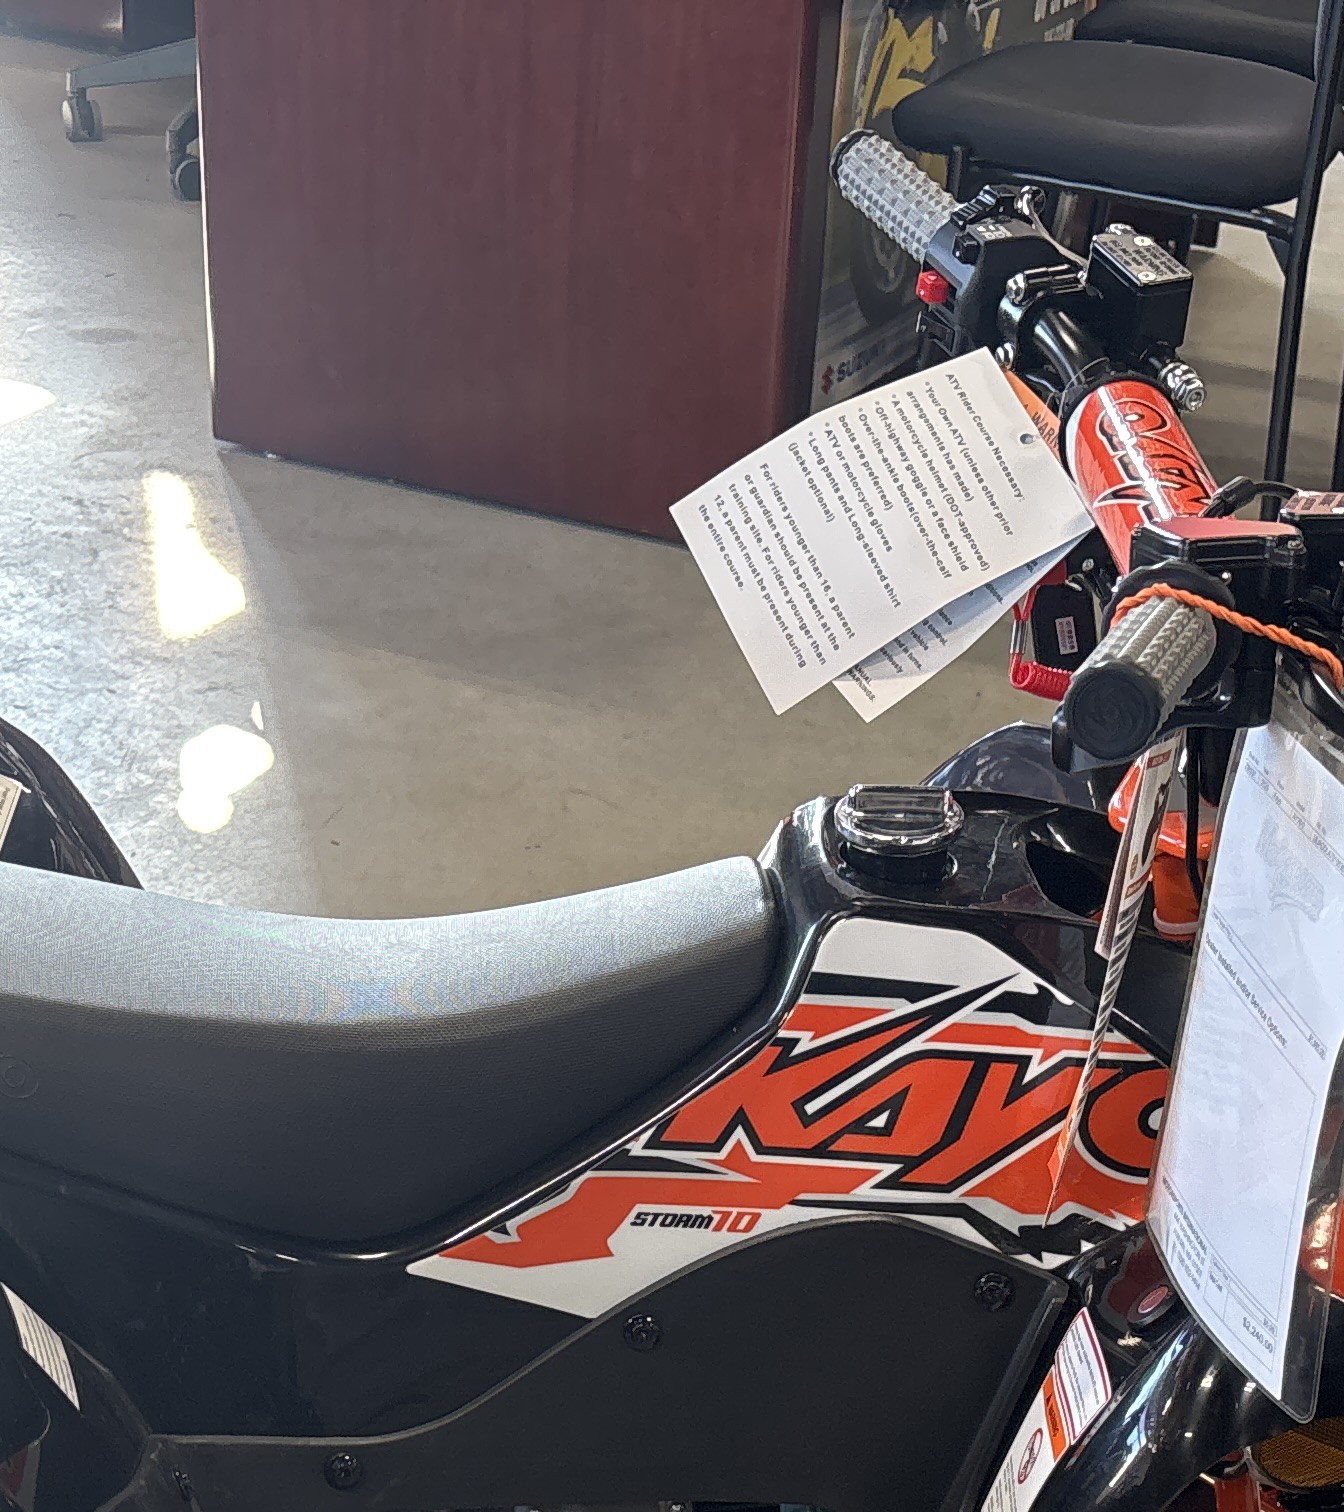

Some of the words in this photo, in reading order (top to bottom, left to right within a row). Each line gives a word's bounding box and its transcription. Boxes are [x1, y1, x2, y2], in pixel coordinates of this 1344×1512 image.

[788, 442, 811, 476] (jacket
[807, 477, 834, 522] optional)
[838, 414, 856, 442] boots
[853, 443, 865, 459] are
[860, 460, 893, 510] preferred)
[906, 391, 945, 451] arrangements
[942, 451, 955, 470] has
[952, 471, 974, 501] made)
[925, 386, 941, 406] Your
[938, 407, 952, 427] Own
[949, 428, 966, 445] ATV
[959, 447, 984, 483] (unless
[981, 485, 999, 510] other
[994, 511, 1013, 535] prior
[945, 374, 961, 389] ATV
[957, 391, 975, 414] Rider
[972, 415, 994, 446] Course
[698, 504, 709, 522] the
[707, 523, 725, 552] entire
[723, 553, 743, 592] course.
[744, 474, 753, 484] or
[749, 486, 776, 530] guardian
[774, 531, 796, 566] should
[792, 566, 802, 580] be
[798, 581, 824, 621] present
[820, 621, 830, 633] at
[827, 632, 839, 650] the
[759, 462, 772, 480] For
[769, 482, 787, 512] riders
[783, 512, 810, 553] younger
[807, 554, 822, 579] than
[820, 579, 831, 596] 16,
[831, 604, 855, 639] parent
[808, 437, 825, 465] Long
[820, 465, 840, 493] pants
[837, 494, 852, 513] and
[848, 513, 887, 581] Long-sleeved
[883, 582, 900, 607] shirt
[824, 429, 840, 447] ATV
[835, 450, 845, 460] or
[842, 462, 874, 517] motorcycle
[869, 518, 892, 552] gloves
[858, 413, 899, 483] Over-the-ankle
[897, 483, 951, 577] boots(over-the-calf
[875, 406, 909, 461] Off-highway
[905, 463, 927, 497] goggle
[925, 498, 935, 508] or
[935, 517, 950, 539] face
[947, 540, 969, 571] shield
[896, 407, 928, 458] motorcycle
[925, 459, 947, 492] helmet
[943, 493, 989, 571] (DOT-approved)
[714, 494, 724, 511] 12,
[724, 519, 747, 552] parent
[743, 552, 760, 578] must
[756, 577, 766, 591] be
[762, 592, 788, 632] present
[785, 632, 806, 668] during
[728, 483, 752, 524] training
[749, 524, 762, 546] site.
[761, 546, 774, 564] For
[771, 565, 789, 596] riders
[785, 597, 813, 639] younger
[810, 640, 825, 665] than
[630, 1210, 762, 1233] STORM70
[1242, 1316, 1274, 1354] $2,240.00
